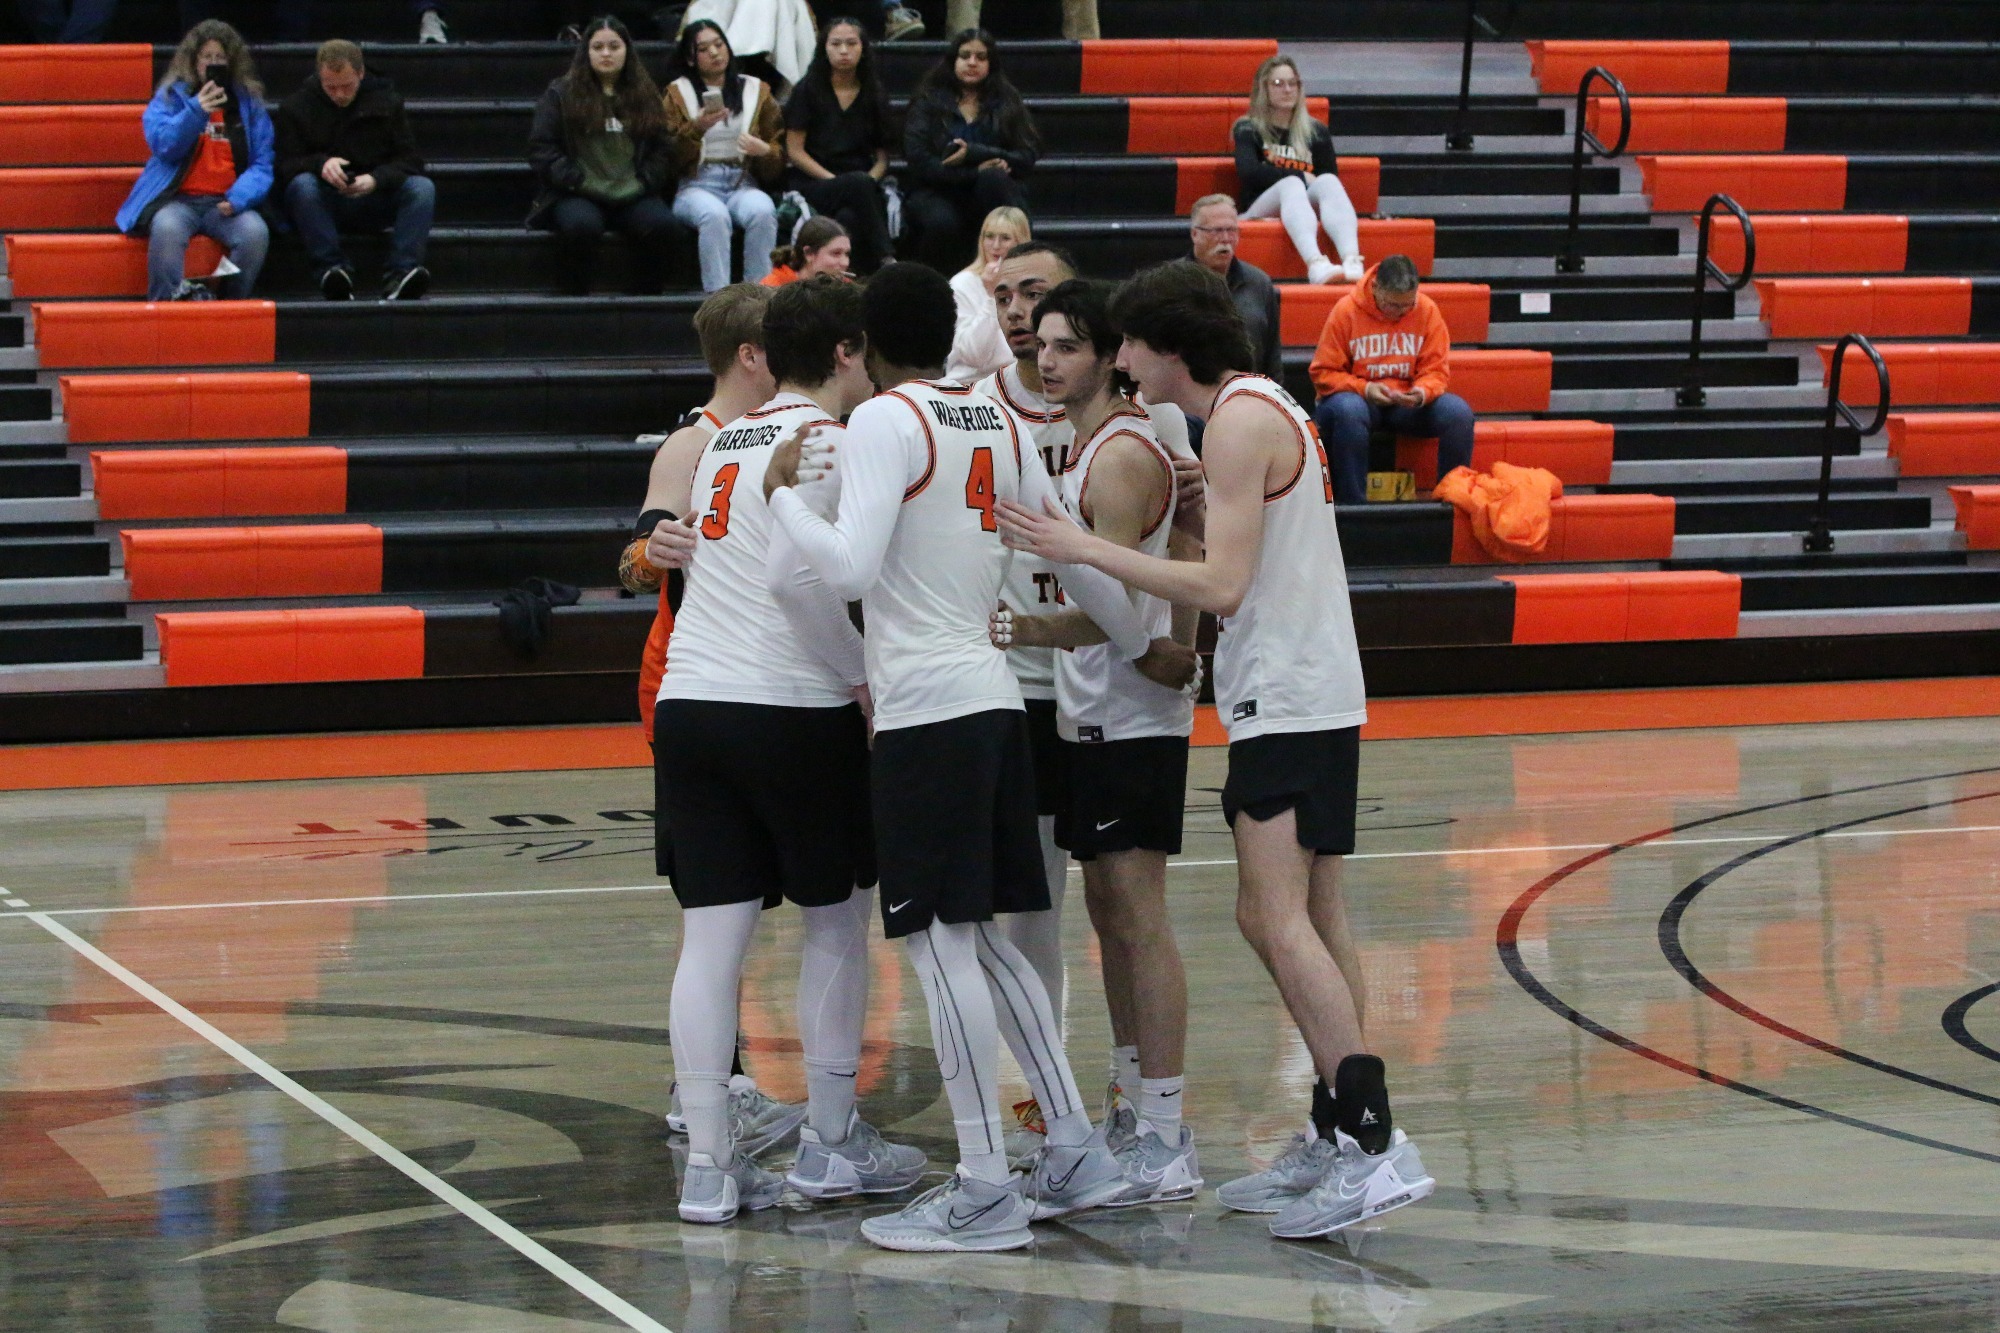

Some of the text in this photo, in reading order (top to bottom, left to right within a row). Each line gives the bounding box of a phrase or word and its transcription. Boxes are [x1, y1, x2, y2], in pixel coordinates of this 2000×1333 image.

[711, 424, 782, 453] WARRIORS
[700, 462, 740, 541] 3
[965, 446, 997, 533] 4
